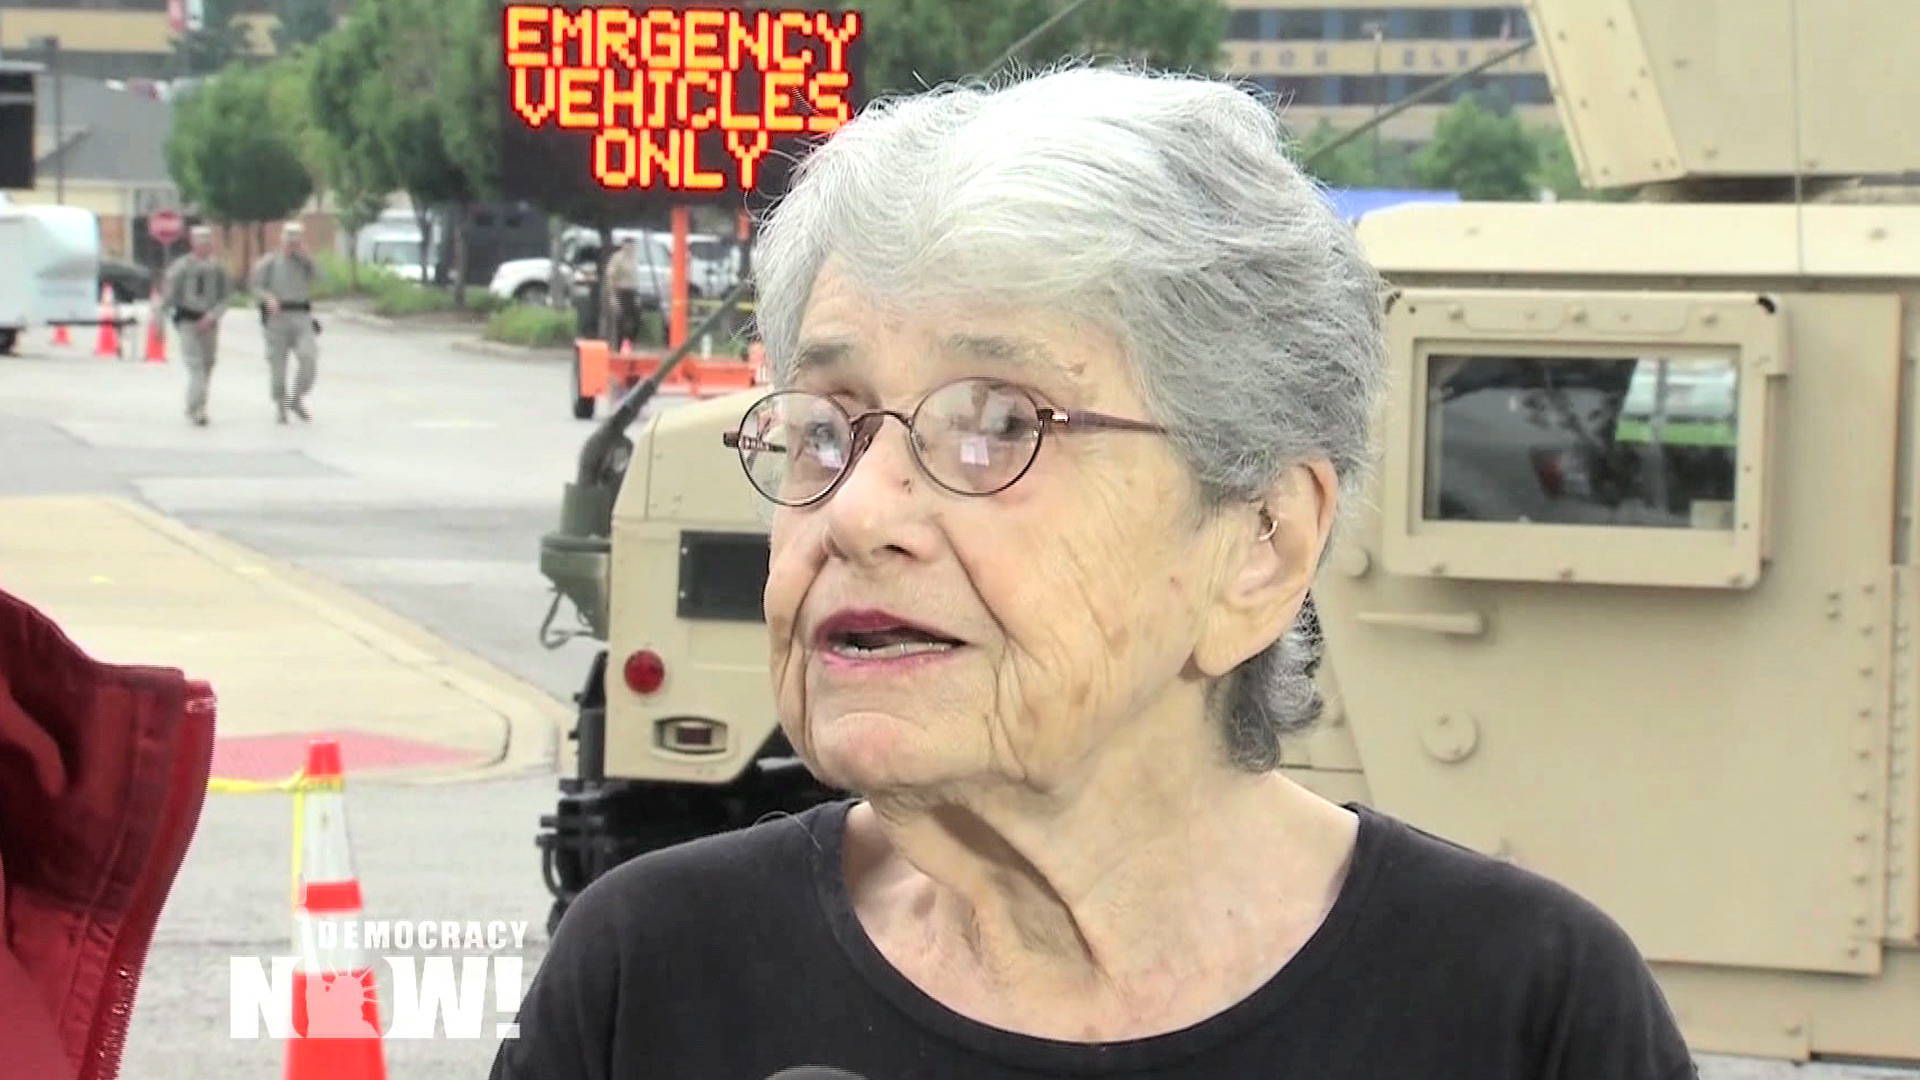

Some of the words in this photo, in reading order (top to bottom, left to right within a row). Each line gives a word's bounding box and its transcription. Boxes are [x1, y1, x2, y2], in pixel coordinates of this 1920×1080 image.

[505, 6, 860, 72] EMRGENCY
[513, 66, 850, 131] VEHICLES
[593, 127, 768, 189] ONLY
